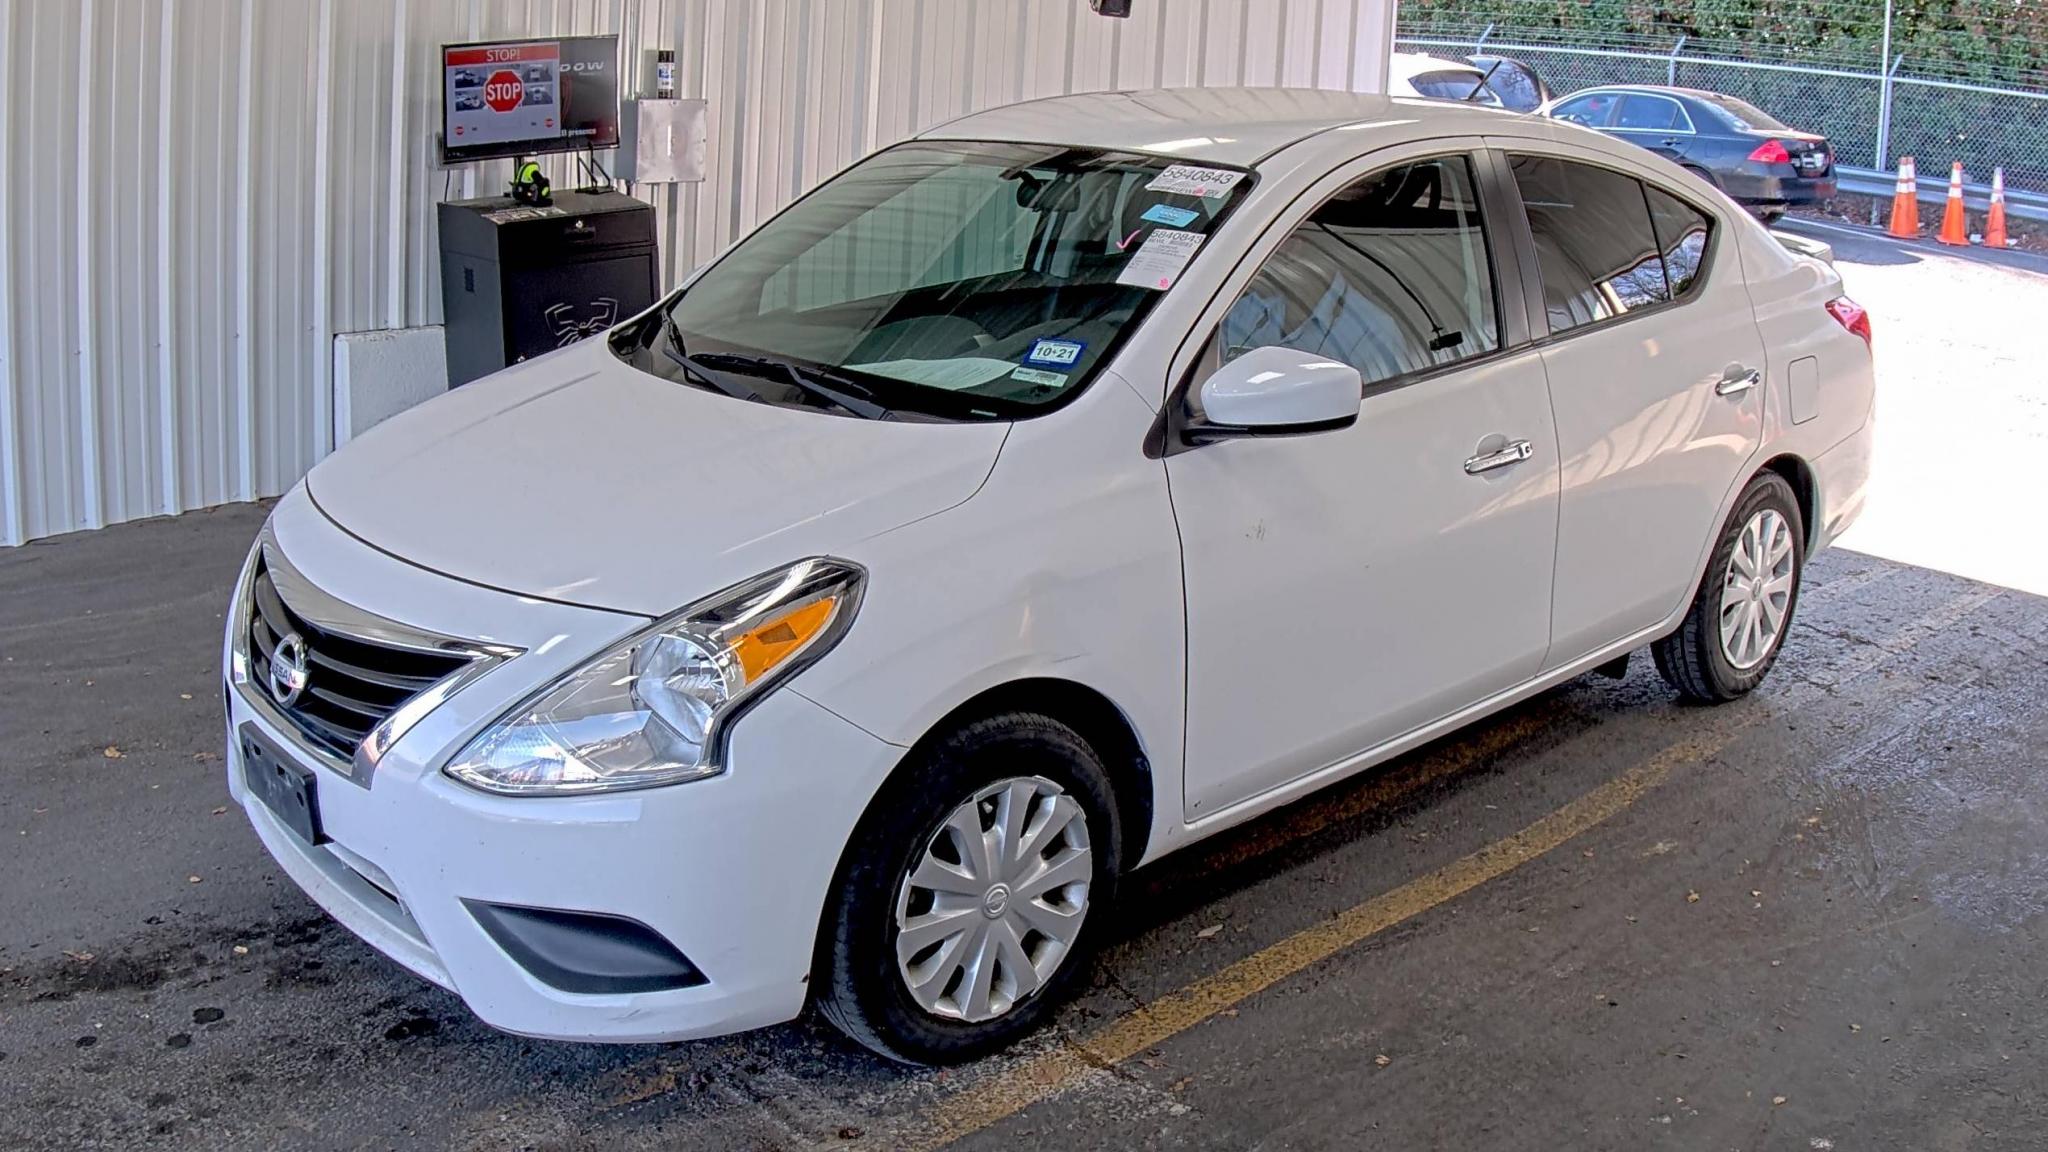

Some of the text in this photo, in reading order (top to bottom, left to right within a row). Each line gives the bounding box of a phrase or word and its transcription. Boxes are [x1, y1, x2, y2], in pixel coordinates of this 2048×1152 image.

[486, 48, 521, 62] STOP!
[486, 82, 521, 102] STOP
[1162, 167, 1234, 185] 5840843
[1151, 230, 1204, 244] 5840843
